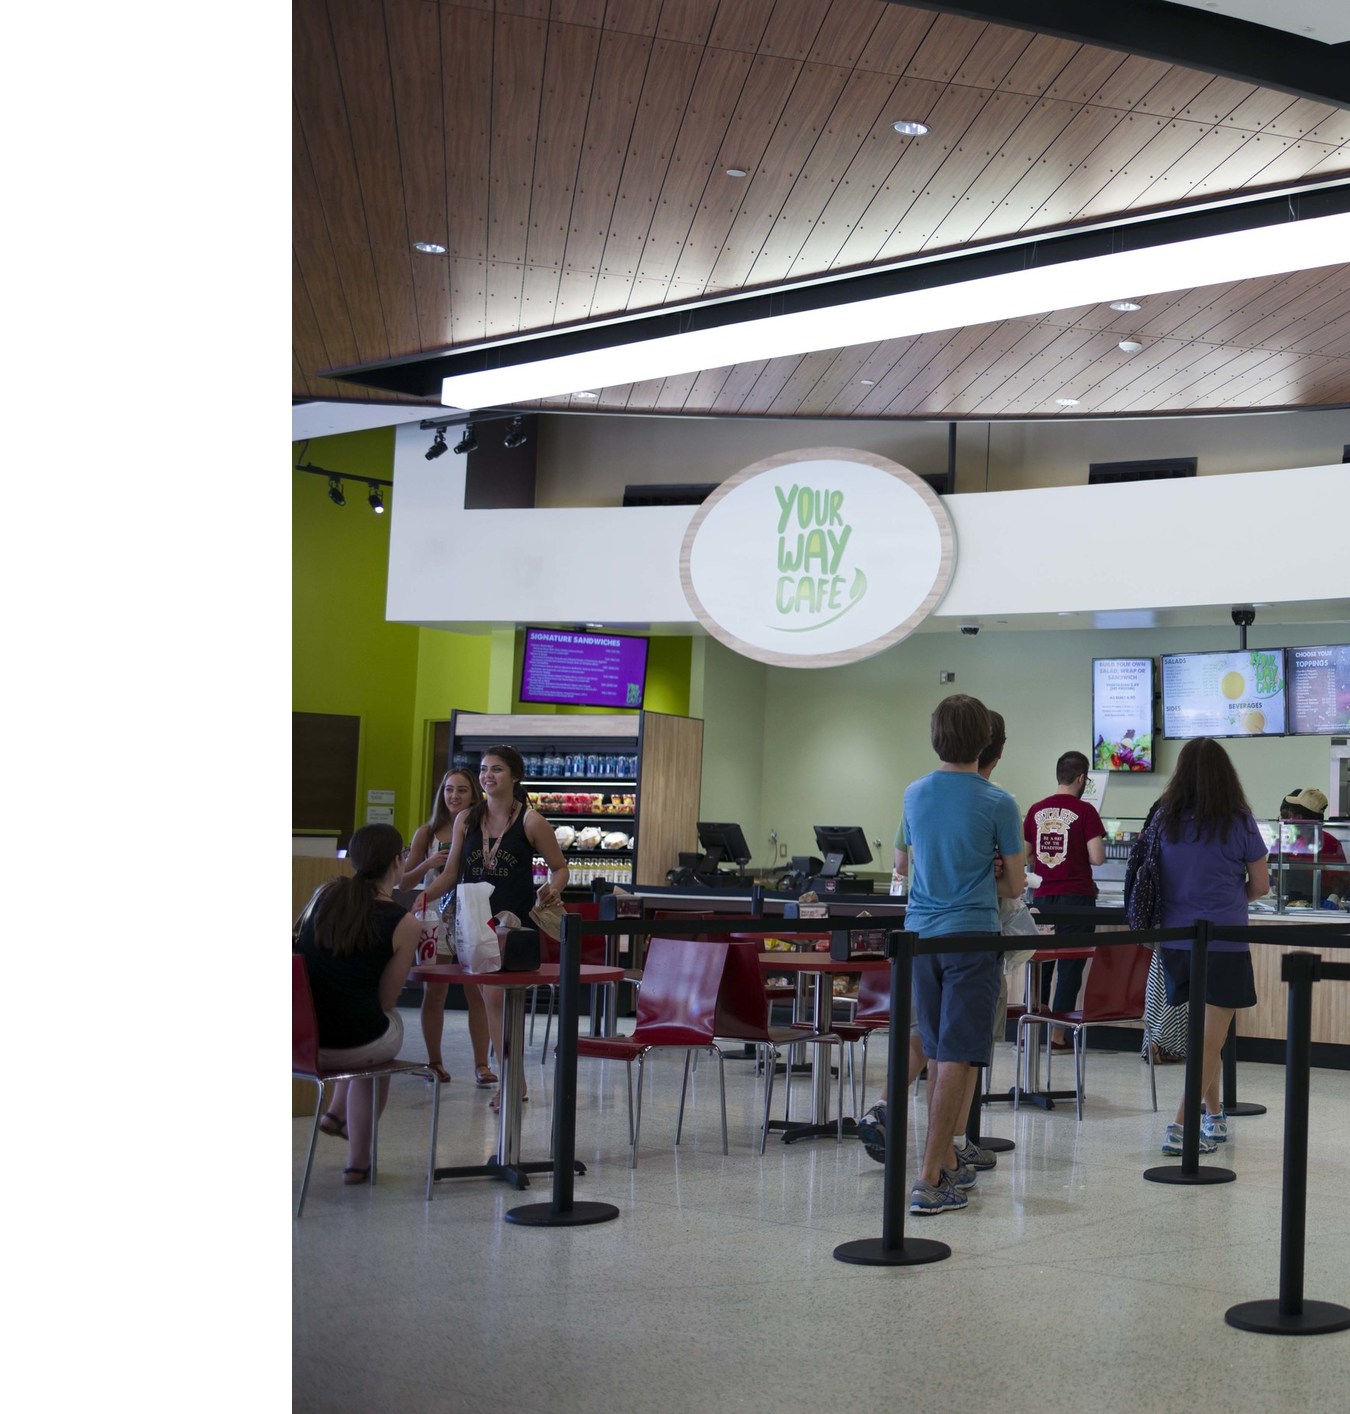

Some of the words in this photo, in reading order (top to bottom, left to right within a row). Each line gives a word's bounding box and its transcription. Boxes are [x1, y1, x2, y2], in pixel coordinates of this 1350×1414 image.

[774, 483, 844, 534] YOUR
[777, 524, 852, 575] WAY
[530, 633, 572, 643] SIGNATURE
[573, 637, 620, 647] SANDWICHES
[1295, 660, 1328, 668] TOPPINGS
[1229, 702, 1262, 710] BEVERAGES
[497, 850, 518, 867] STATE
